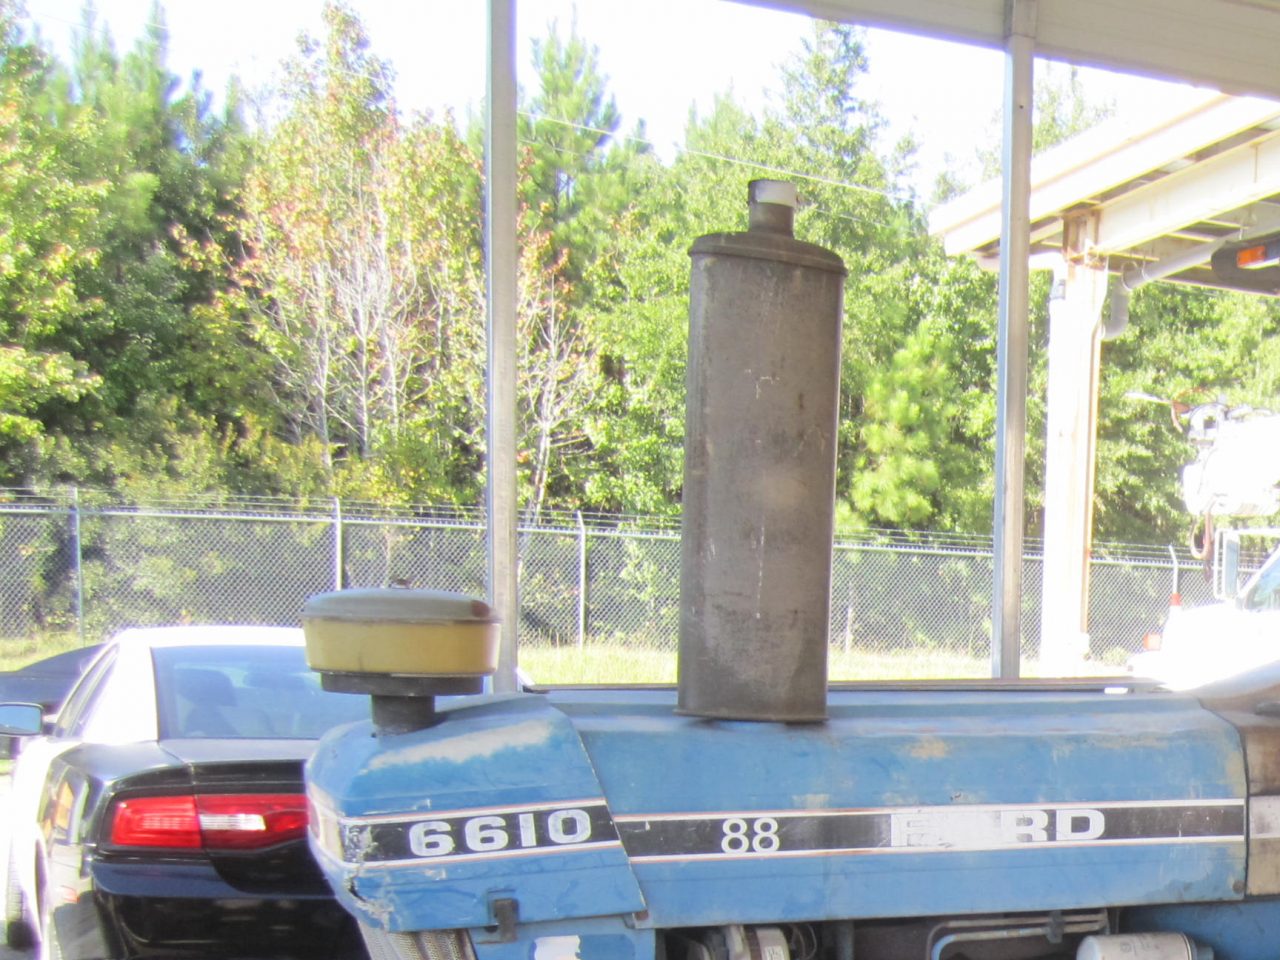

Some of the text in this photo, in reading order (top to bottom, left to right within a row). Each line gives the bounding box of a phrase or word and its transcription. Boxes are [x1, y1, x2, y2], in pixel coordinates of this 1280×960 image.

[409, 807, 592, 857] 6610
[721, 817, 781, 854] 88
[891, 809, 1106, 847] FRD
